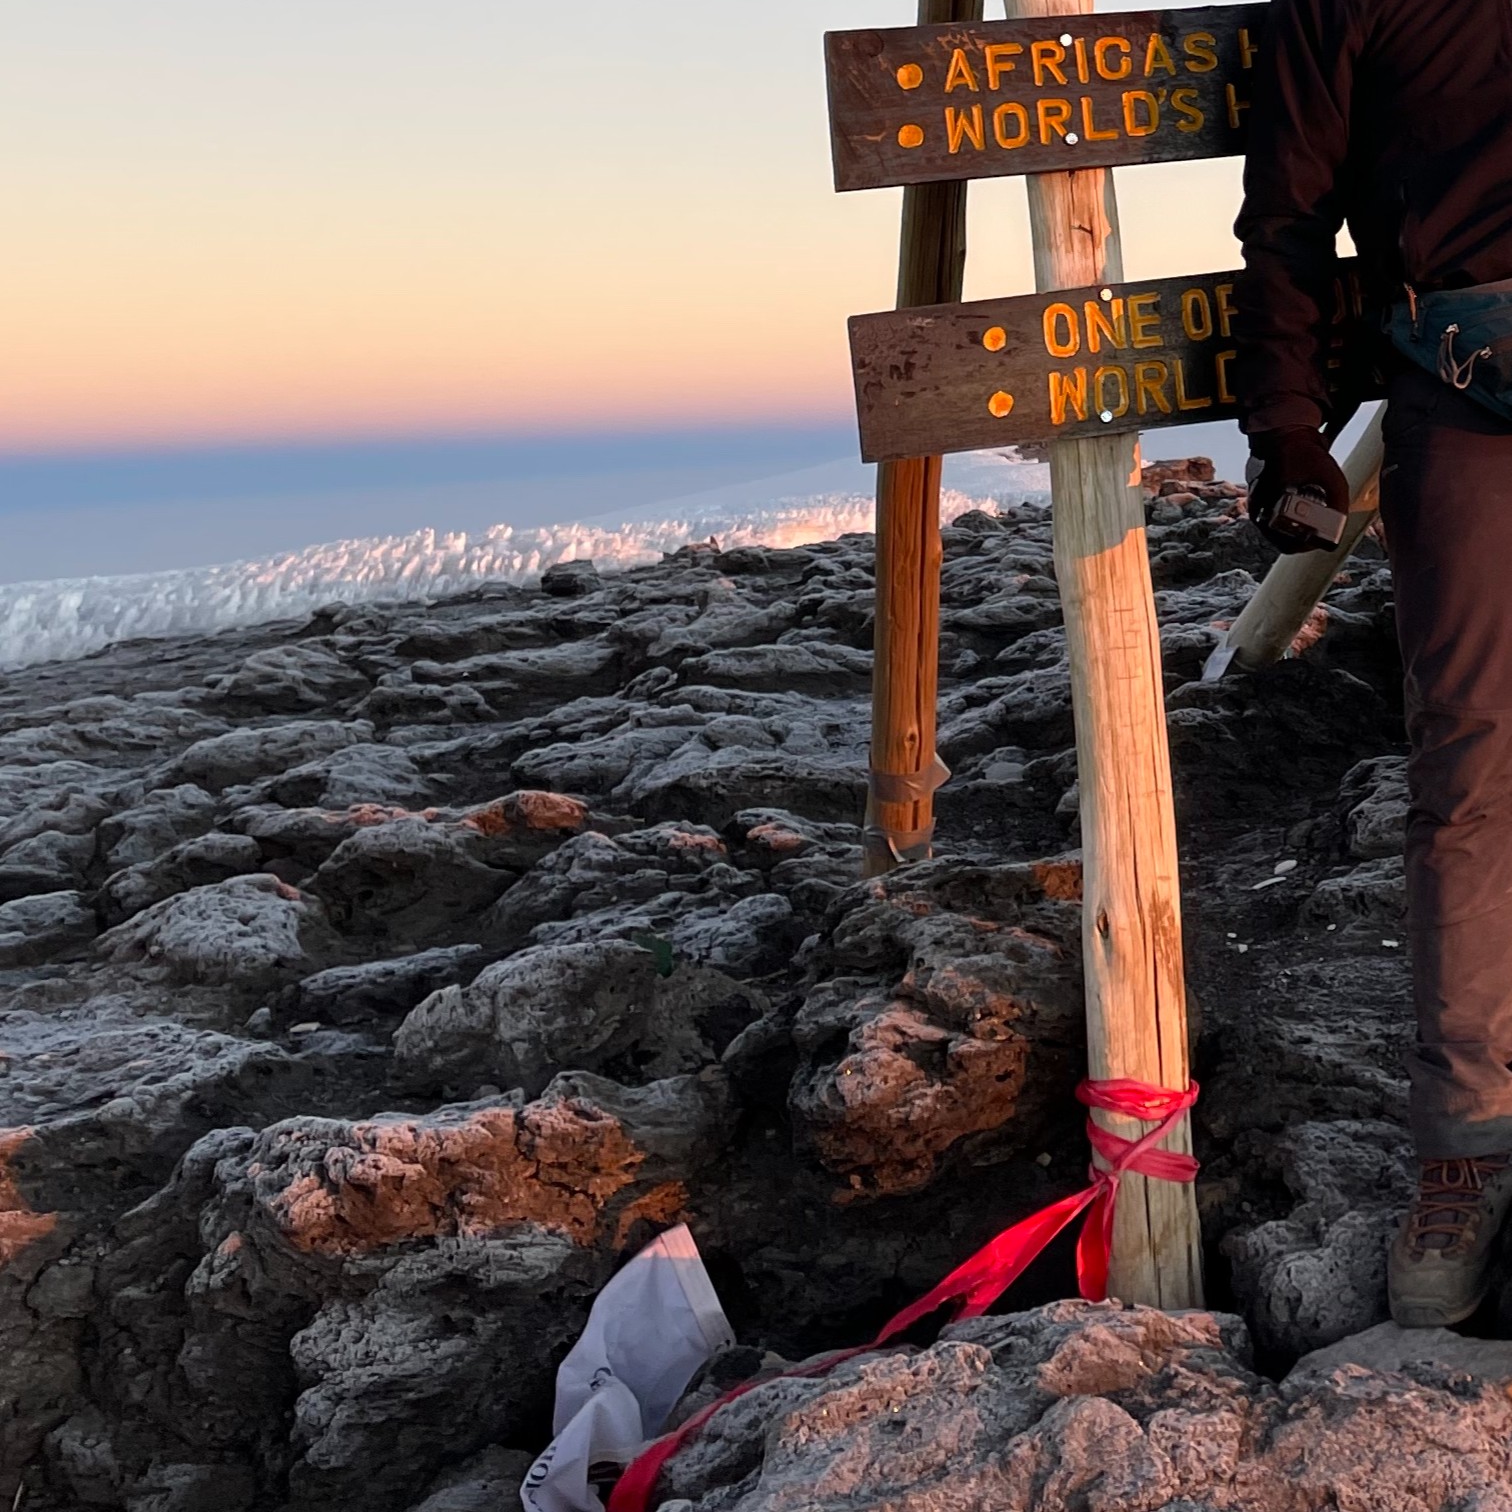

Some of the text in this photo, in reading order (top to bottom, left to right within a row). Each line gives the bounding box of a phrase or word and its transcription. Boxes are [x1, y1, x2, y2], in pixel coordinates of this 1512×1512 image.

[944, 32, 1218, 93] AFRICAS
[944, 88, 1206, 154] WORLD'S
[1042, 290, 1161, 358] ONE
